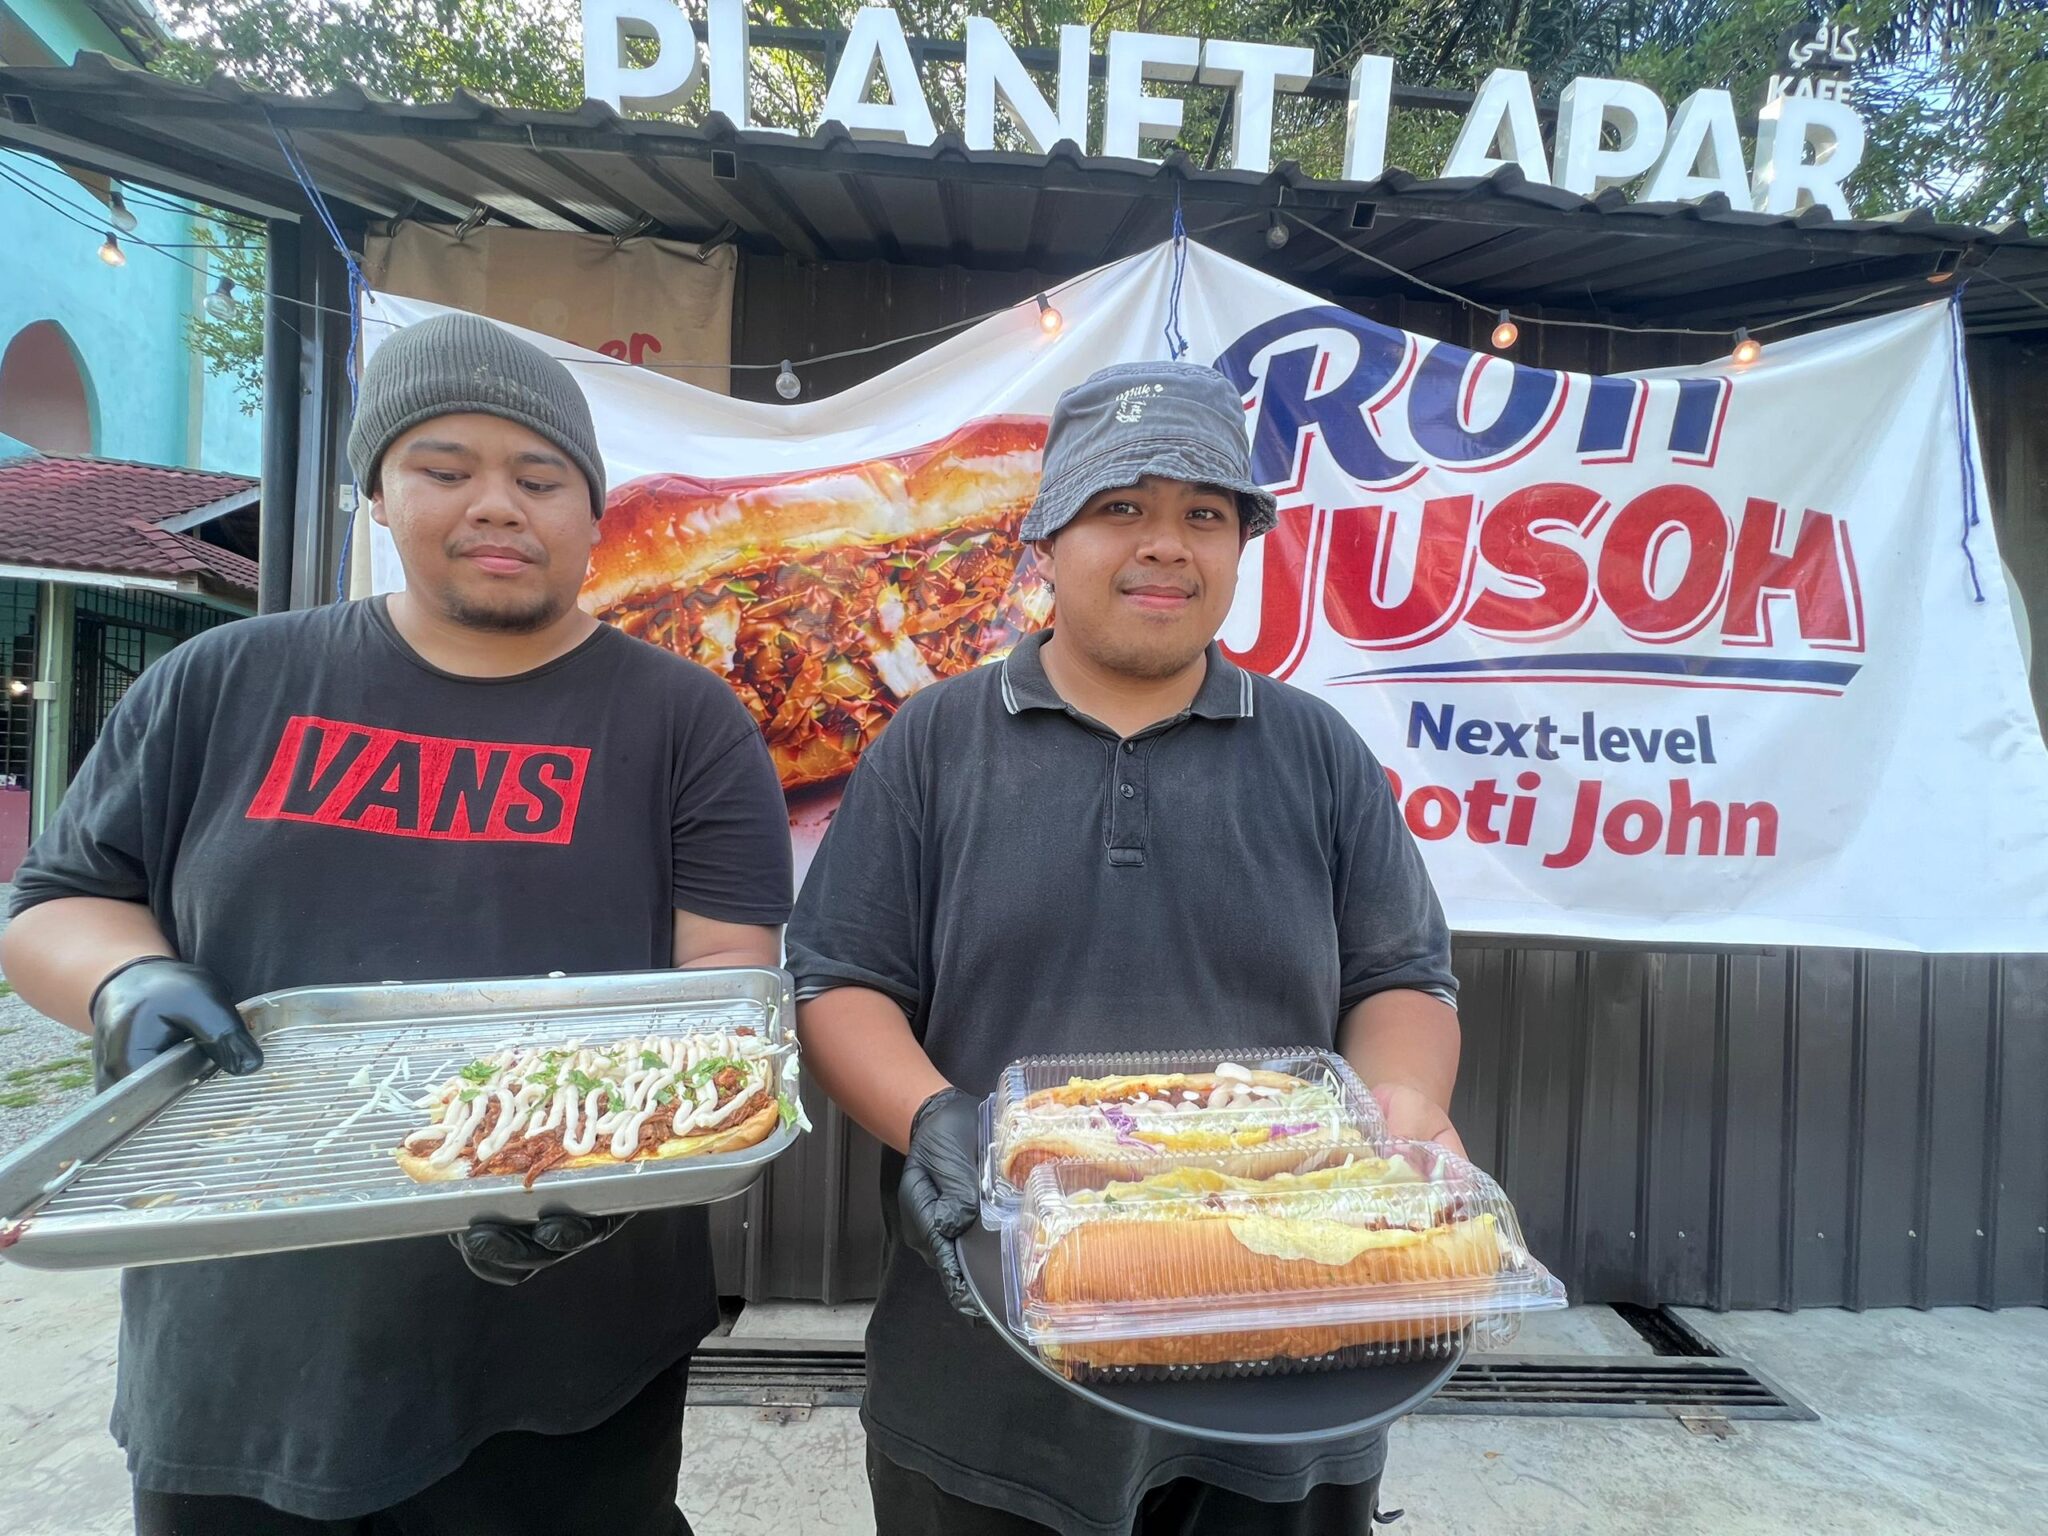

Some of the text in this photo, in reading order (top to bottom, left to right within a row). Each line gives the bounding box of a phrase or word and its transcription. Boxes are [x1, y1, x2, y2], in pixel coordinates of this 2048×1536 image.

[583, 0, 1867, 221] PLANET LAPAR
[1220, 482, 1865, 682] JUSOH
[279, 725, 574, 834] VANS
[1407, 701, 1717, 764] Next-level
[1542, 778, 1779, 869] John
